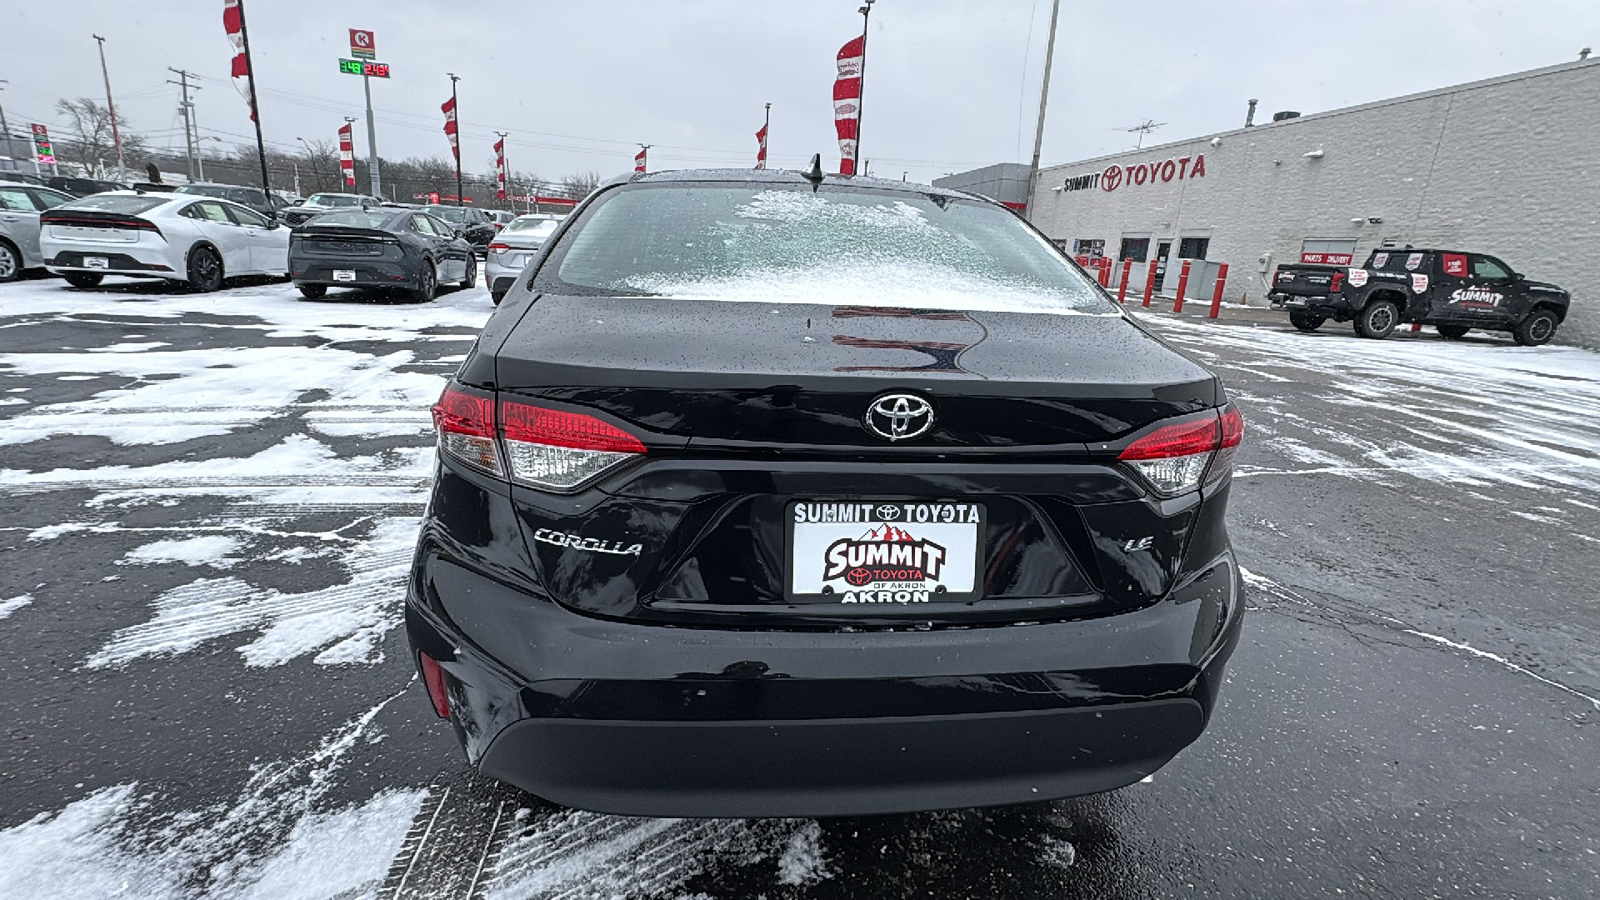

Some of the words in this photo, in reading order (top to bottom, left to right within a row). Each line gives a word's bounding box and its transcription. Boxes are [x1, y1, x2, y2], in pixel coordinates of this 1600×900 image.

[1063, 173, 1100, 192] SUMMIT
[1126, 154, 1206, 185] TOYOTA
[1304, 254, 1323, 263] PARTS
[1327, 255, 1350, 266] DELIVERY
[1449, 288, 1504, 307] SUMMIT
[794, 503, 874, 523] SUMMIT
[903, 504, 980, 523] TOYOTA
[534, 526, 643, 556] COROLLA
[1124, 536, 1154, 552] LE
[826, 541, 944, 579] SUMMIT
[873, 569, 923, 580] TOYOTA
[890, 581, 926, 589] AKRON
[841, 590, 930, 604] AKRON
